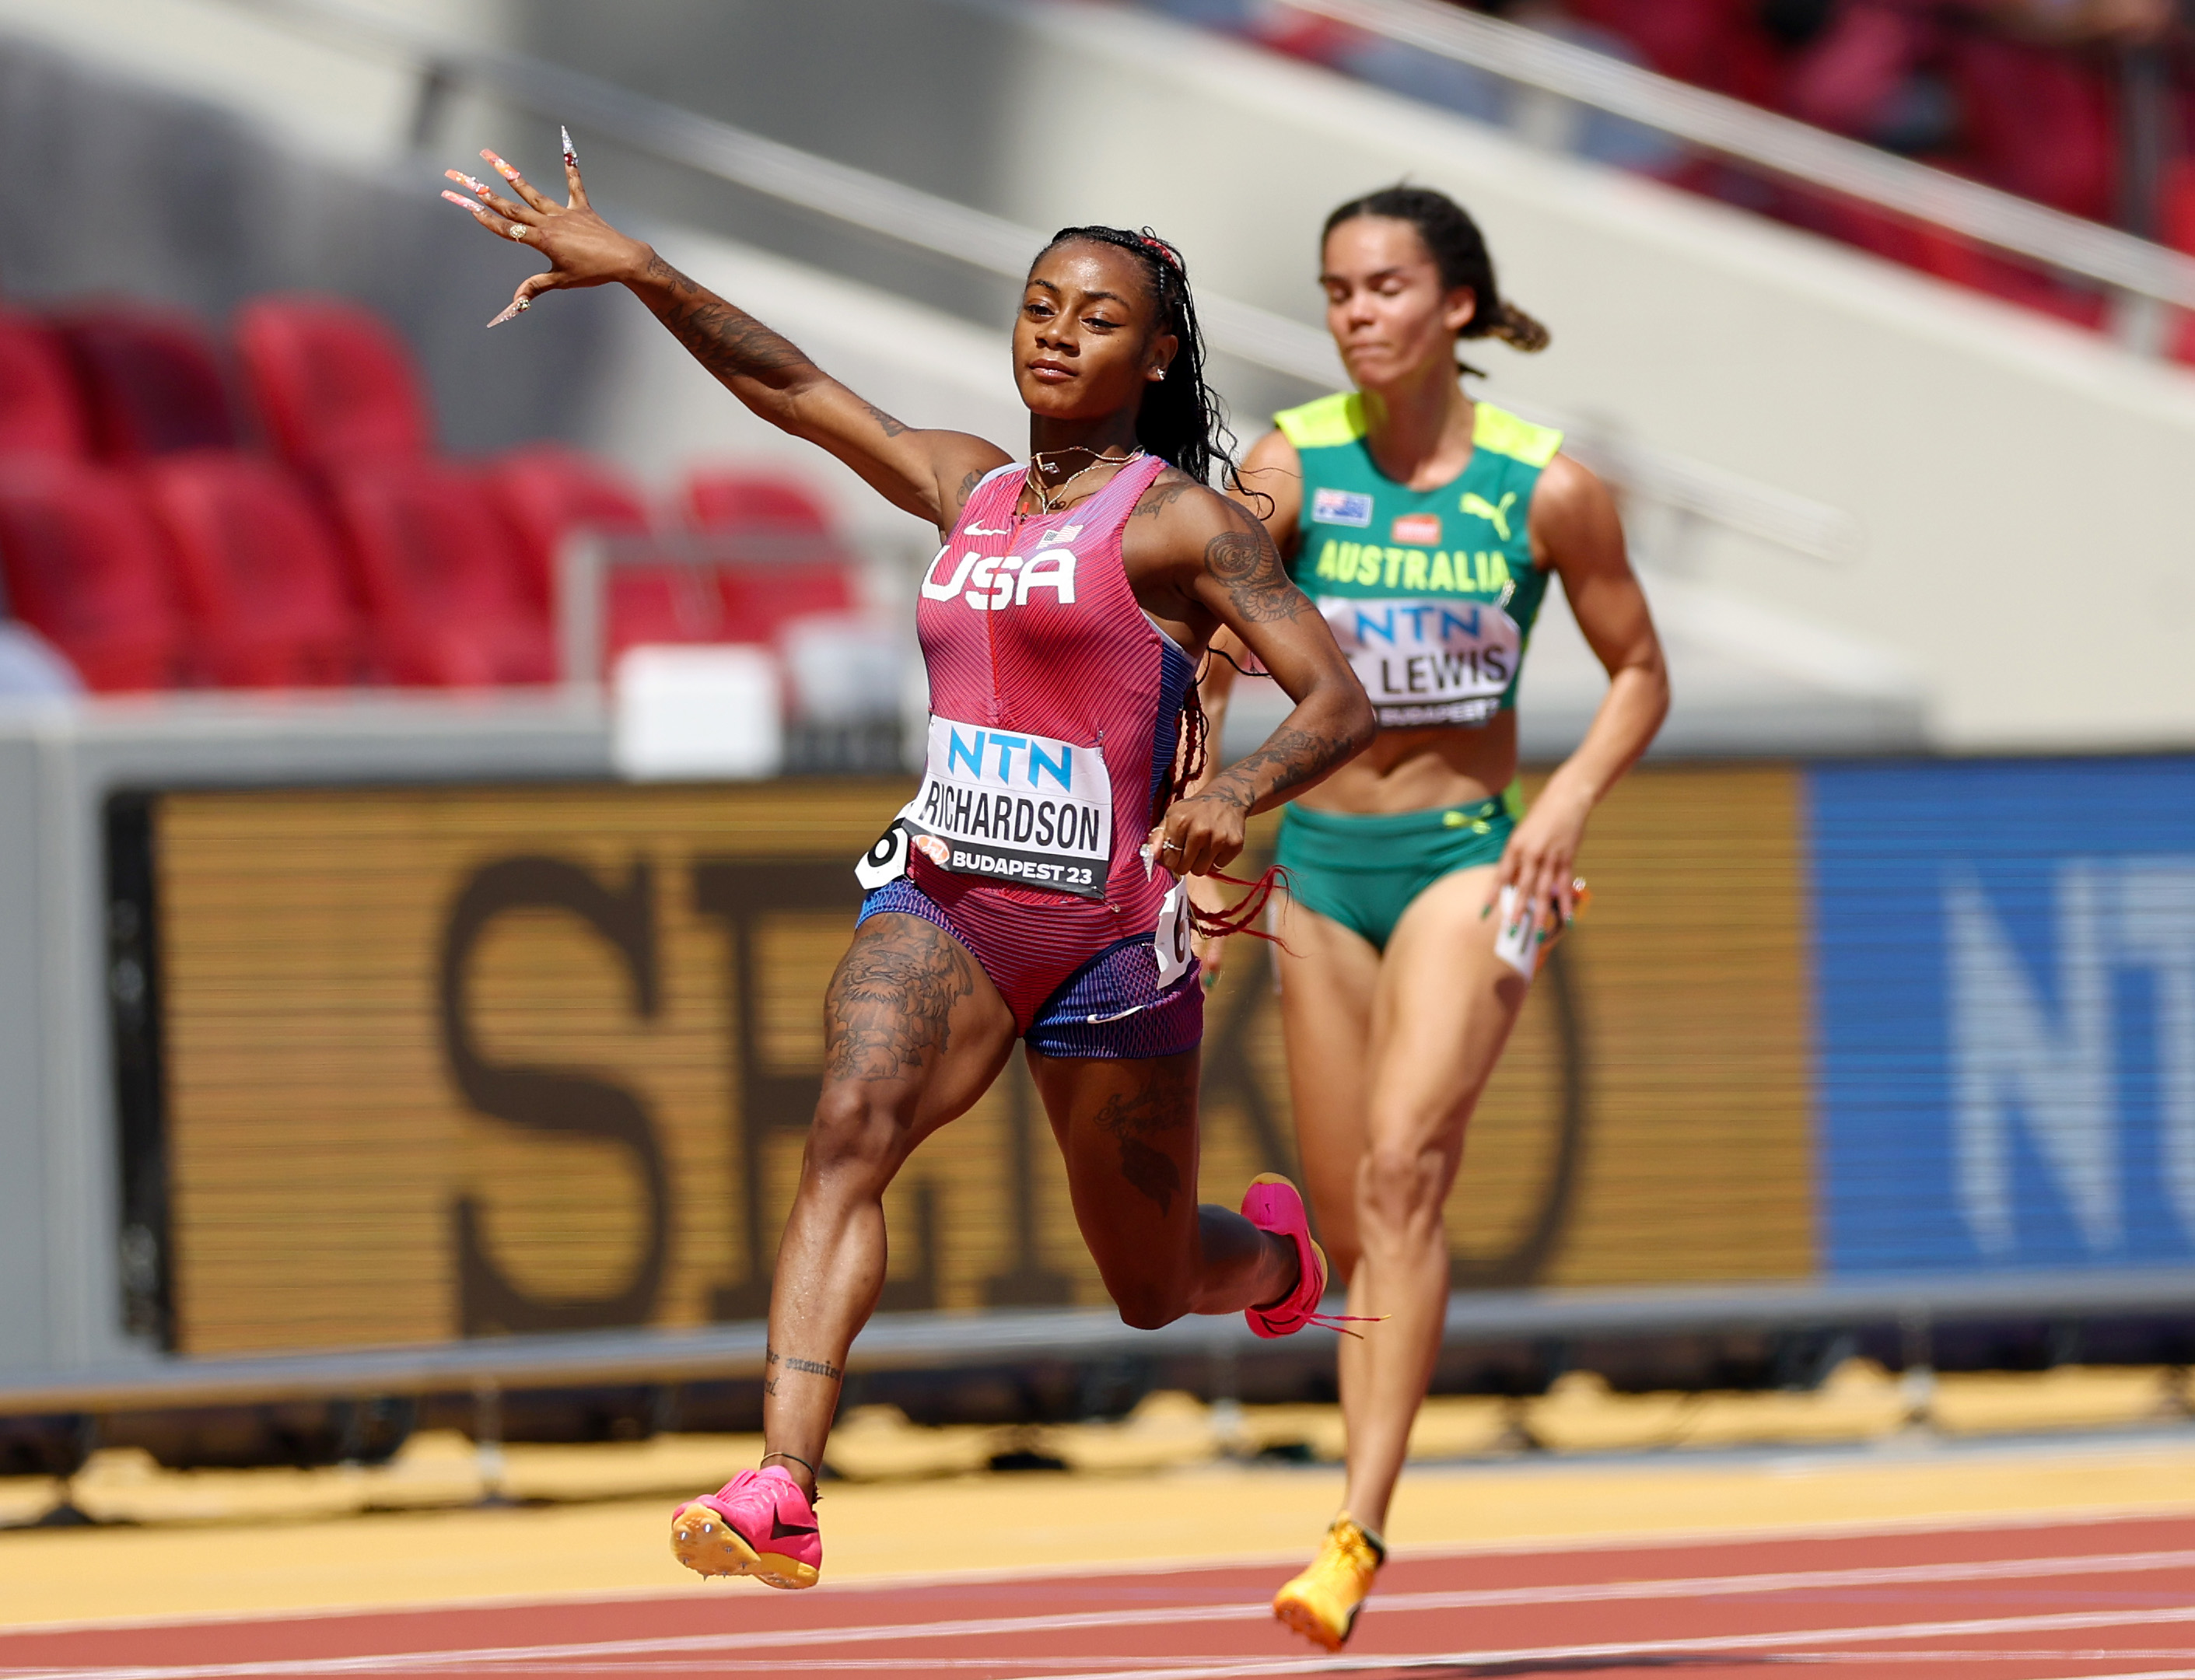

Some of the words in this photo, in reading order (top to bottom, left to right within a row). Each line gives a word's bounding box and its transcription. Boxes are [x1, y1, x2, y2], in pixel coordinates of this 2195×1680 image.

[921, 544, 1076, 610] USA
[1318, 540, 1510, 593] AUSTRALIA
[1355, 604, 1482, 646] NTN
[1381, 645, 1509, 696] LEWIS
[947, 726, 1072, 793] NTN
[919, 780, 1100, 852] RICHARDSON
[951, 854, 1065, 884] BUDAPEST
[1066, 866, 1094, 886] 23
[1174, 895, 1186, 964] 6
